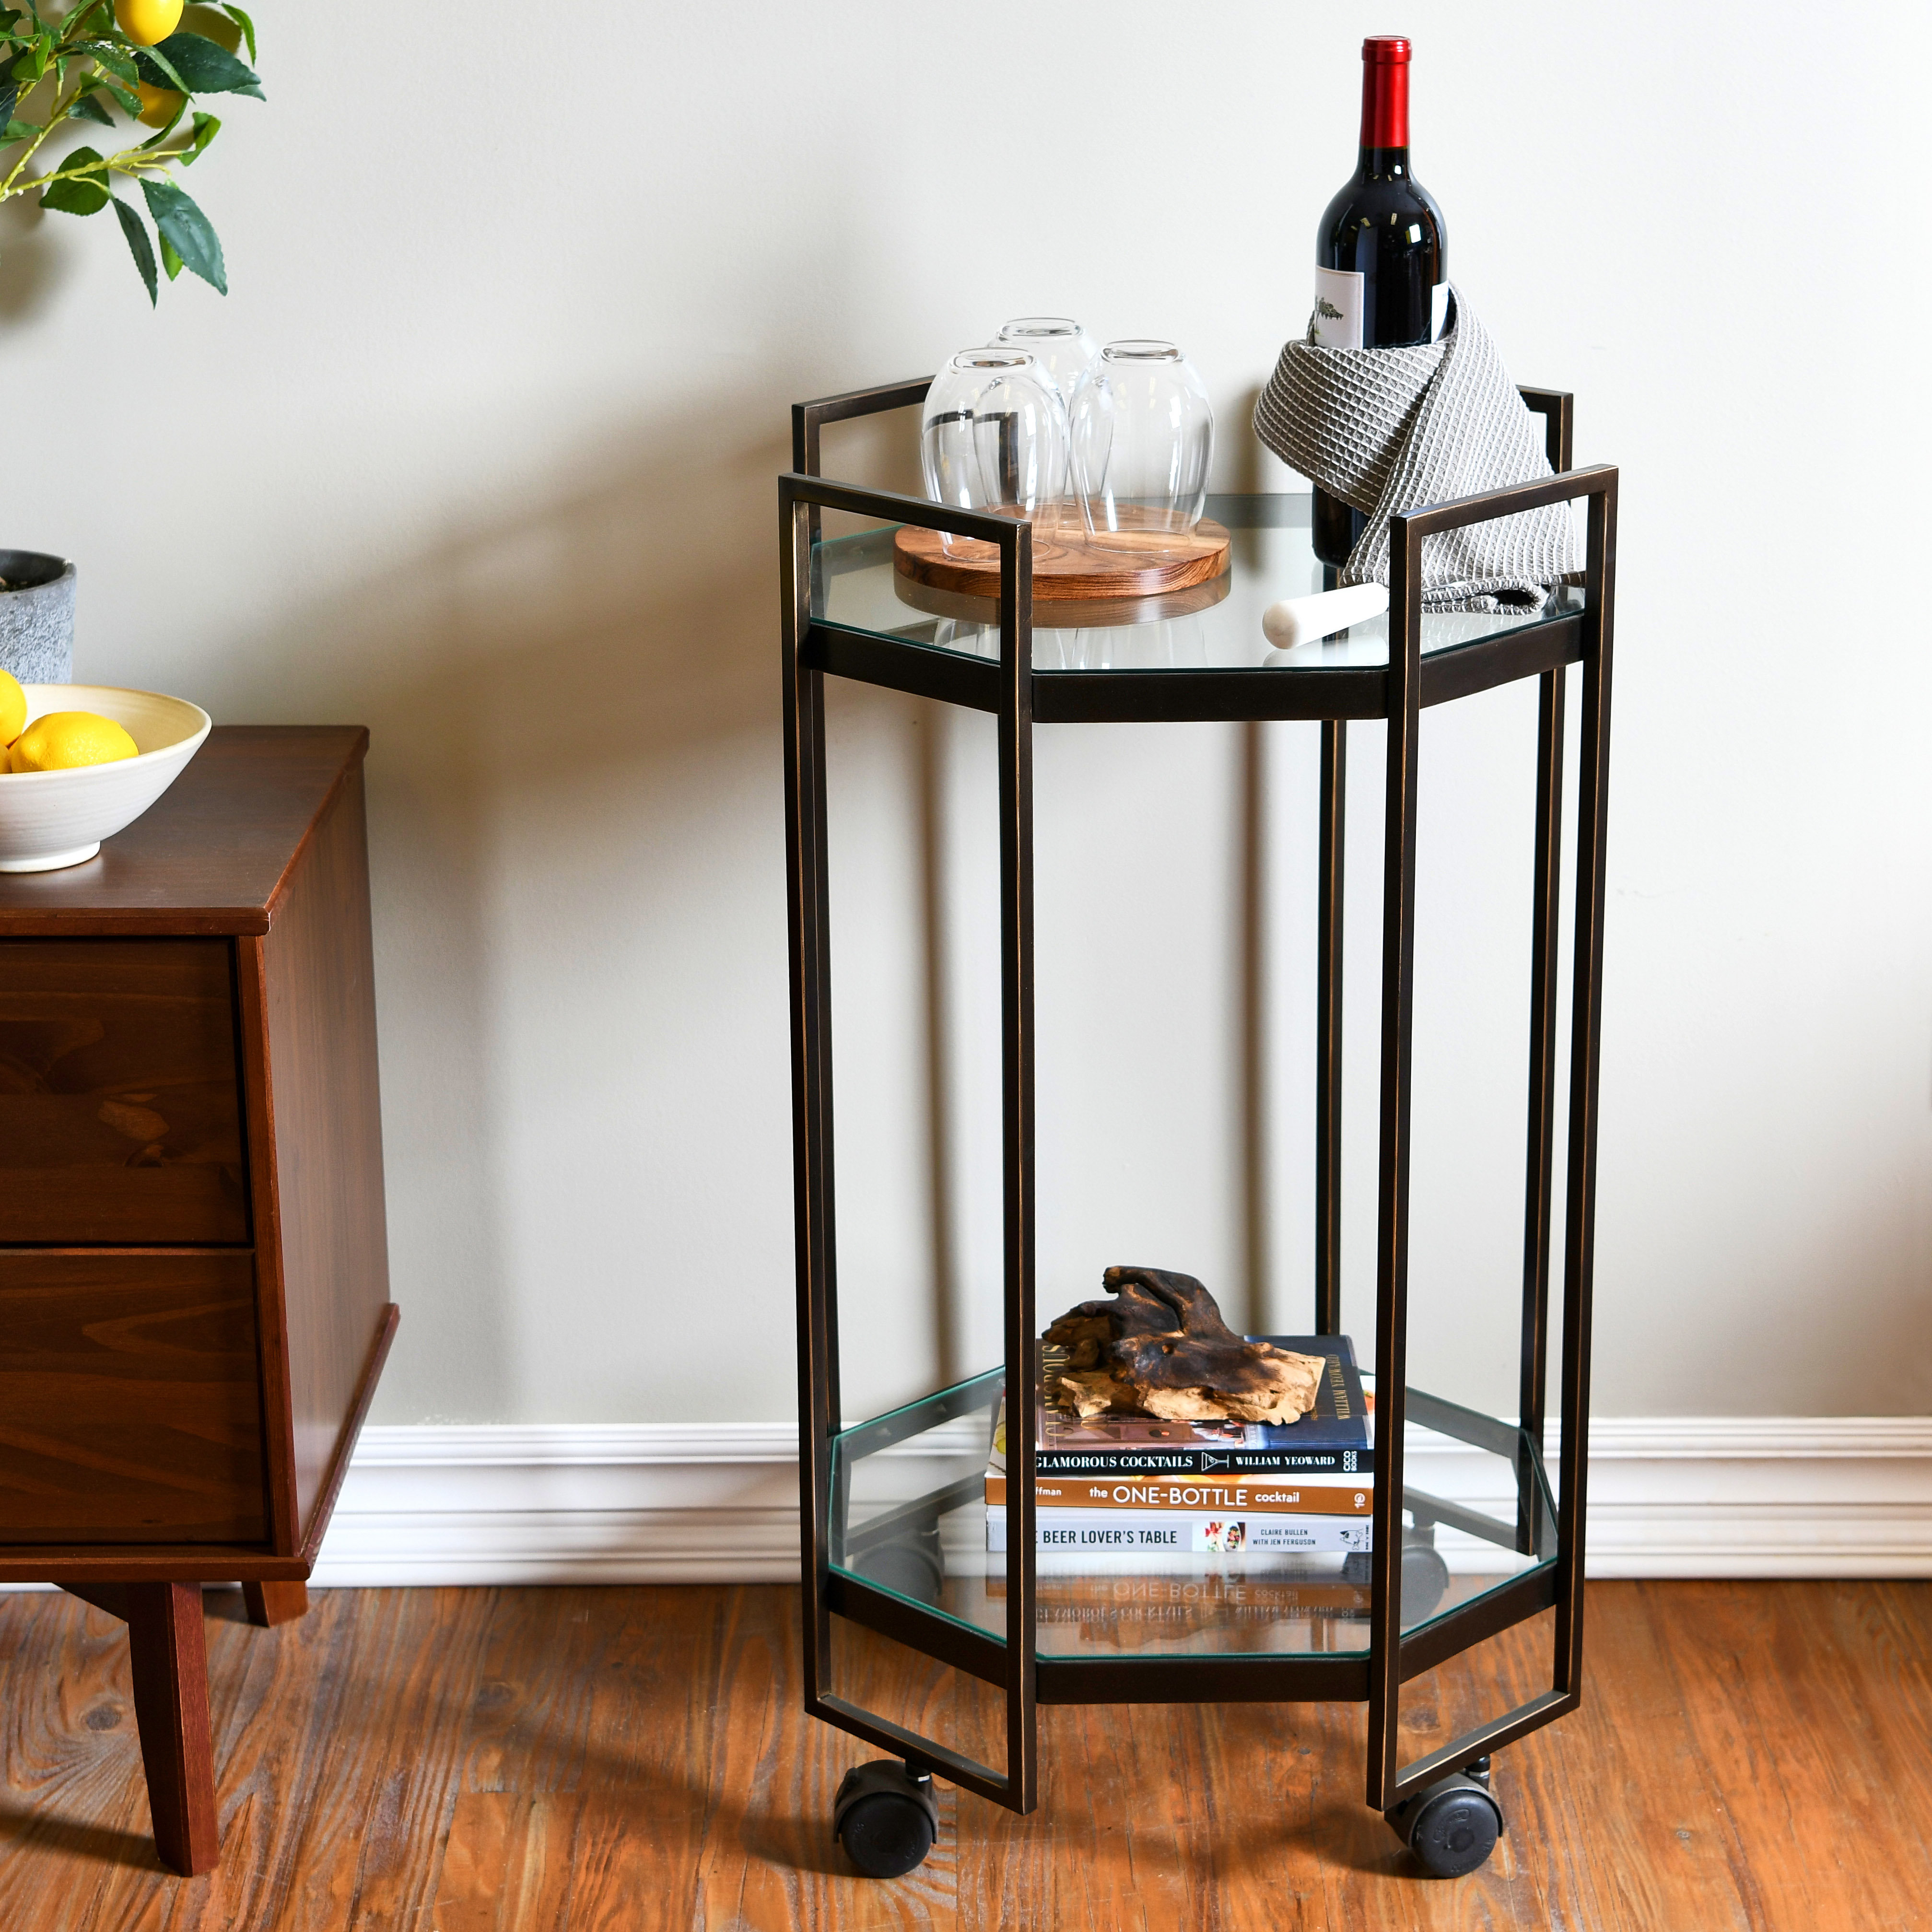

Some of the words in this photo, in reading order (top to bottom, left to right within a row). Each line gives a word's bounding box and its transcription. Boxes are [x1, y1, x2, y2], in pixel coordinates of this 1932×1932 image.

[1120, 1456, 1193, 1468] COCKTAILS
[1236, 1456, 1281, 1466] WILLIAM
[1285, 1456, 1335, 1465] YEOWARD
[1089, 1487, 1108, 1498] the
[1113, 1486, 1248, 1506] ONE-BOTTLE
[1255, 1491, 1300, 1503] cocktail
[1043, 1531, 1077, 1543] BEER
[1081, 1530, 1135, 1544] LOVER'S
[1138, 1531, 1177, 1544] TABLE
